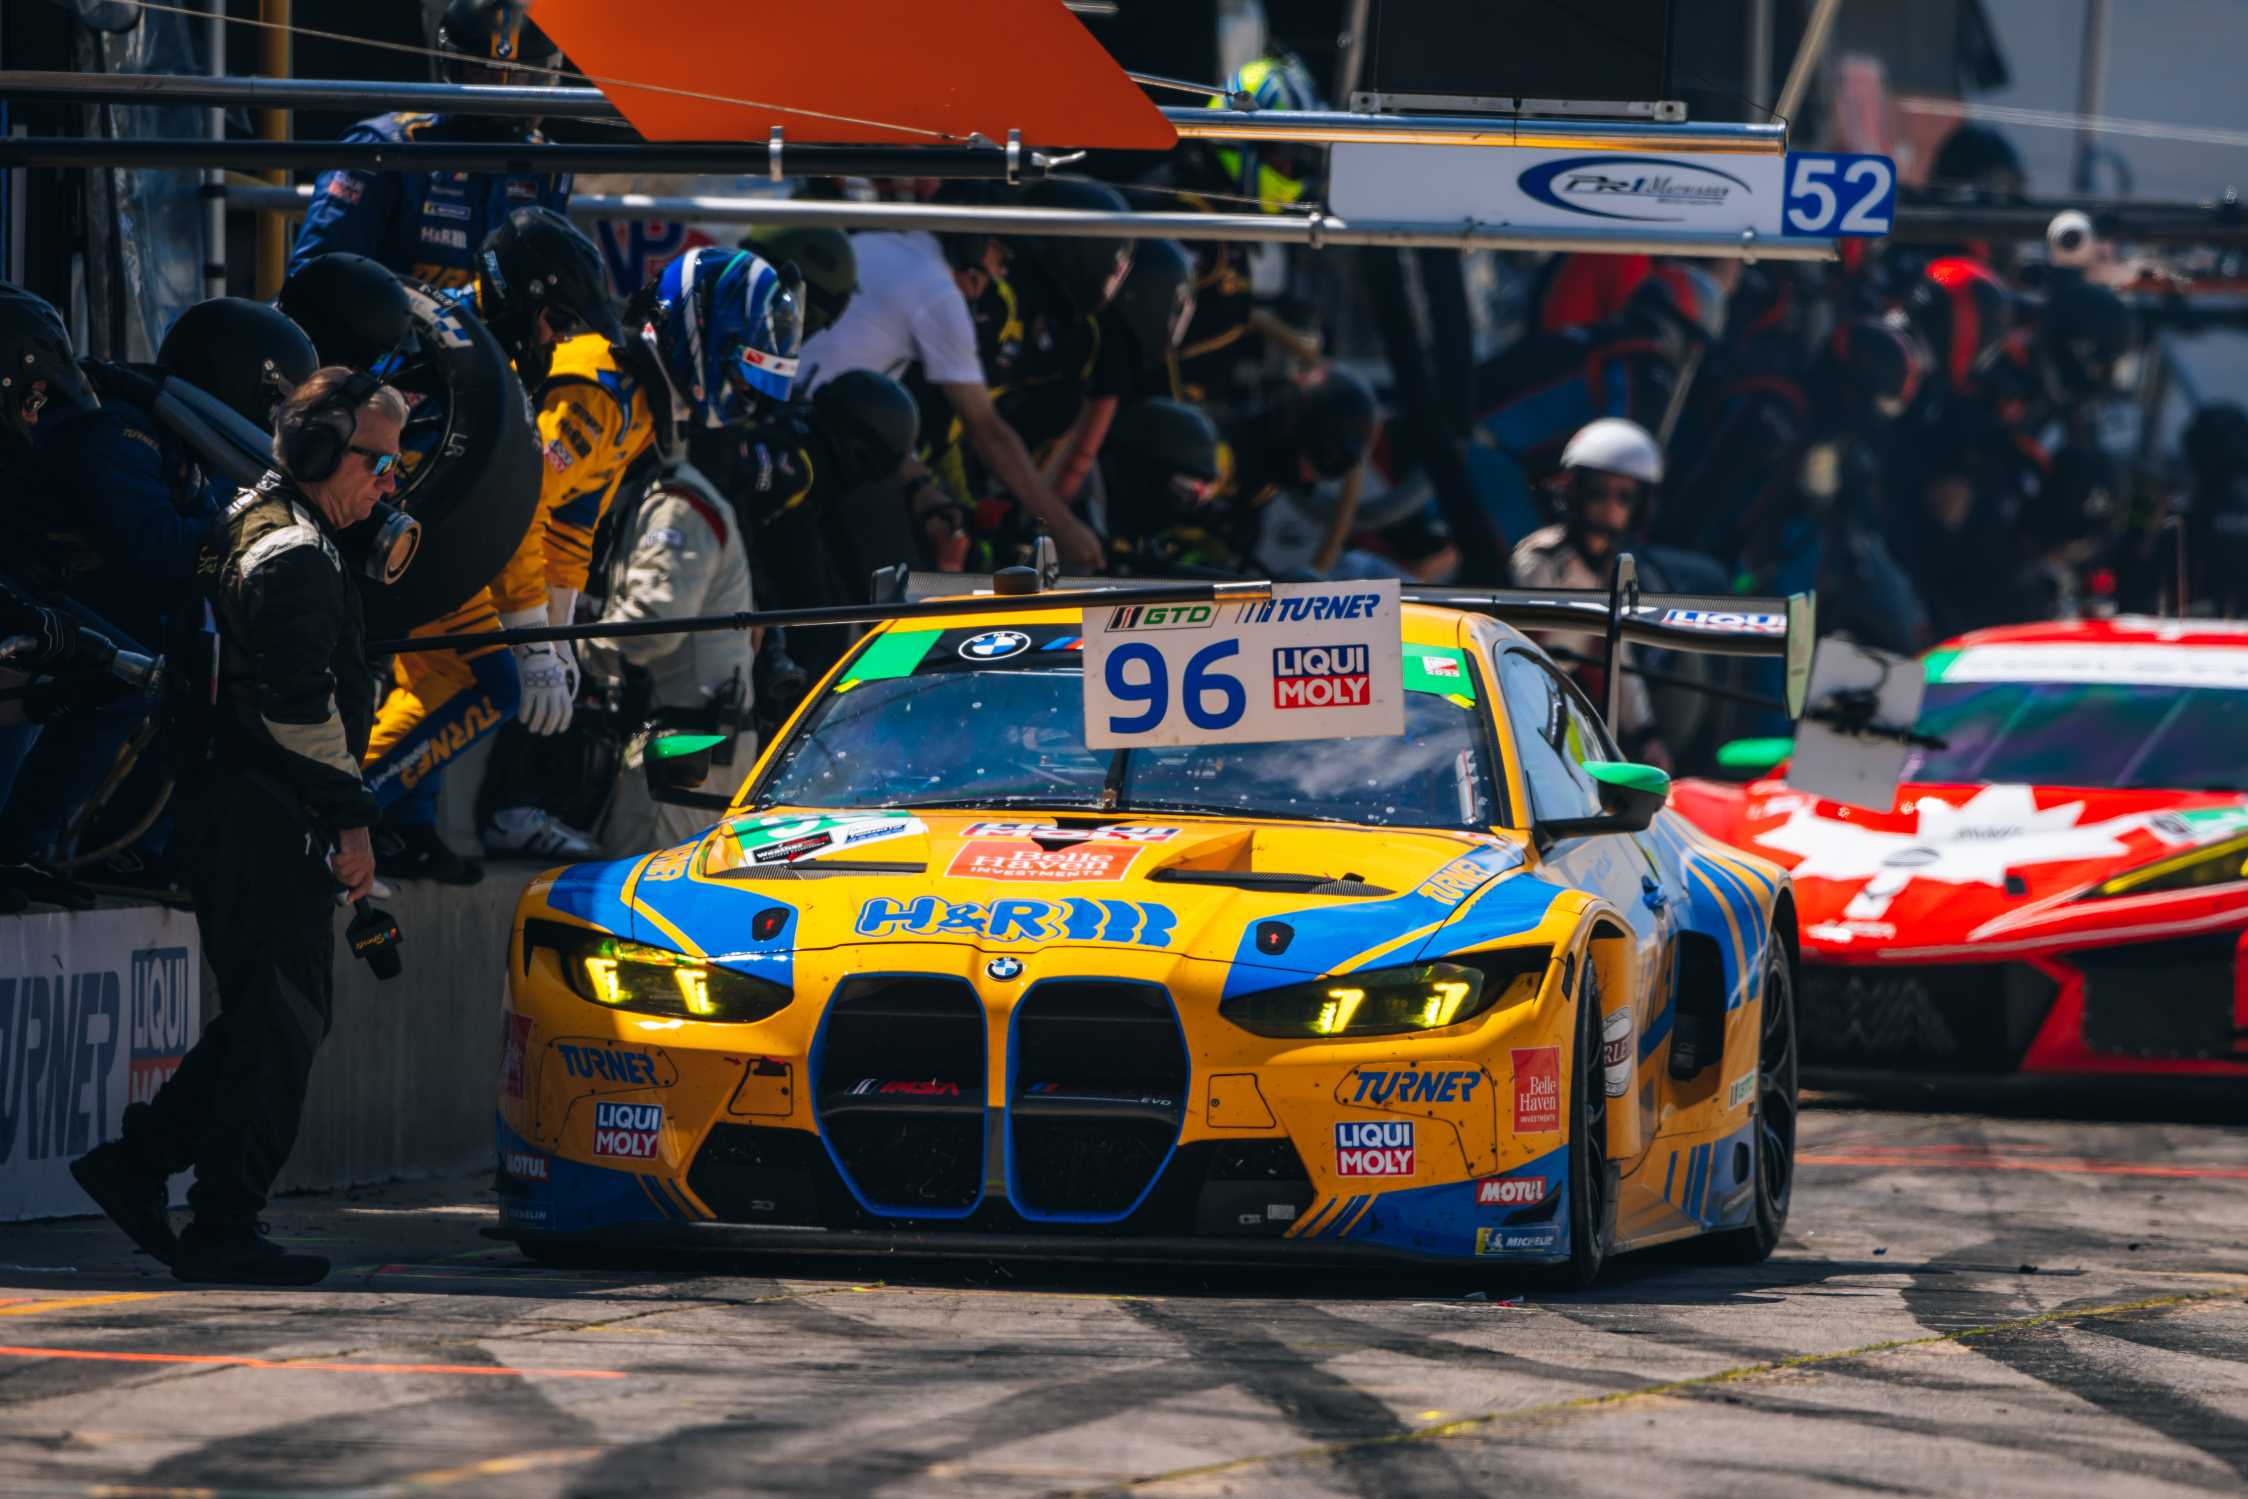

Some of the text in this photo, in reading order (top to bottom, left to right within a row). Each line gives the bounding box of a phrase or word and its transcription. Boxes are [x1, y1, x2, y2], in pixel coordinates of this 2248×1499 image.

[1788, 159, 1891, 233] 52
[1144, 594, 1381, 625] GTD TURNER
[1277, 647, 1365, 677] LIQUI
[1104, 638, 1247, 735] 96
[1278, 678, 1370, 708] MOLY
[970, 856, 1109, 870] Haven
[1012, 851, 1114, 862] Belle
[970, 867, 1104, 877] INVESTMENTS
[856, 896, 1064, 943] H&R
[134, 957, 186, 1053] LIQUI
[0, 971, 120, 1166] URNER
[559, 1043, 659, 1086] TURNER
[1353, 1070, 1482, 1103] TURNER
[1530, 1076, 1556, 1096] Belle
[1520, 1093, 1556, 1112] Haven
[598, 1105, 660, 1130] LIQUI
[596, 1130, 656, 1156] MOLY
[1340, 1123, 1411, 1148] LIQUI
[1340, 1149, 1414, 1174] MOLY
[1480, 1180, 1544, 1202] MOTUL
